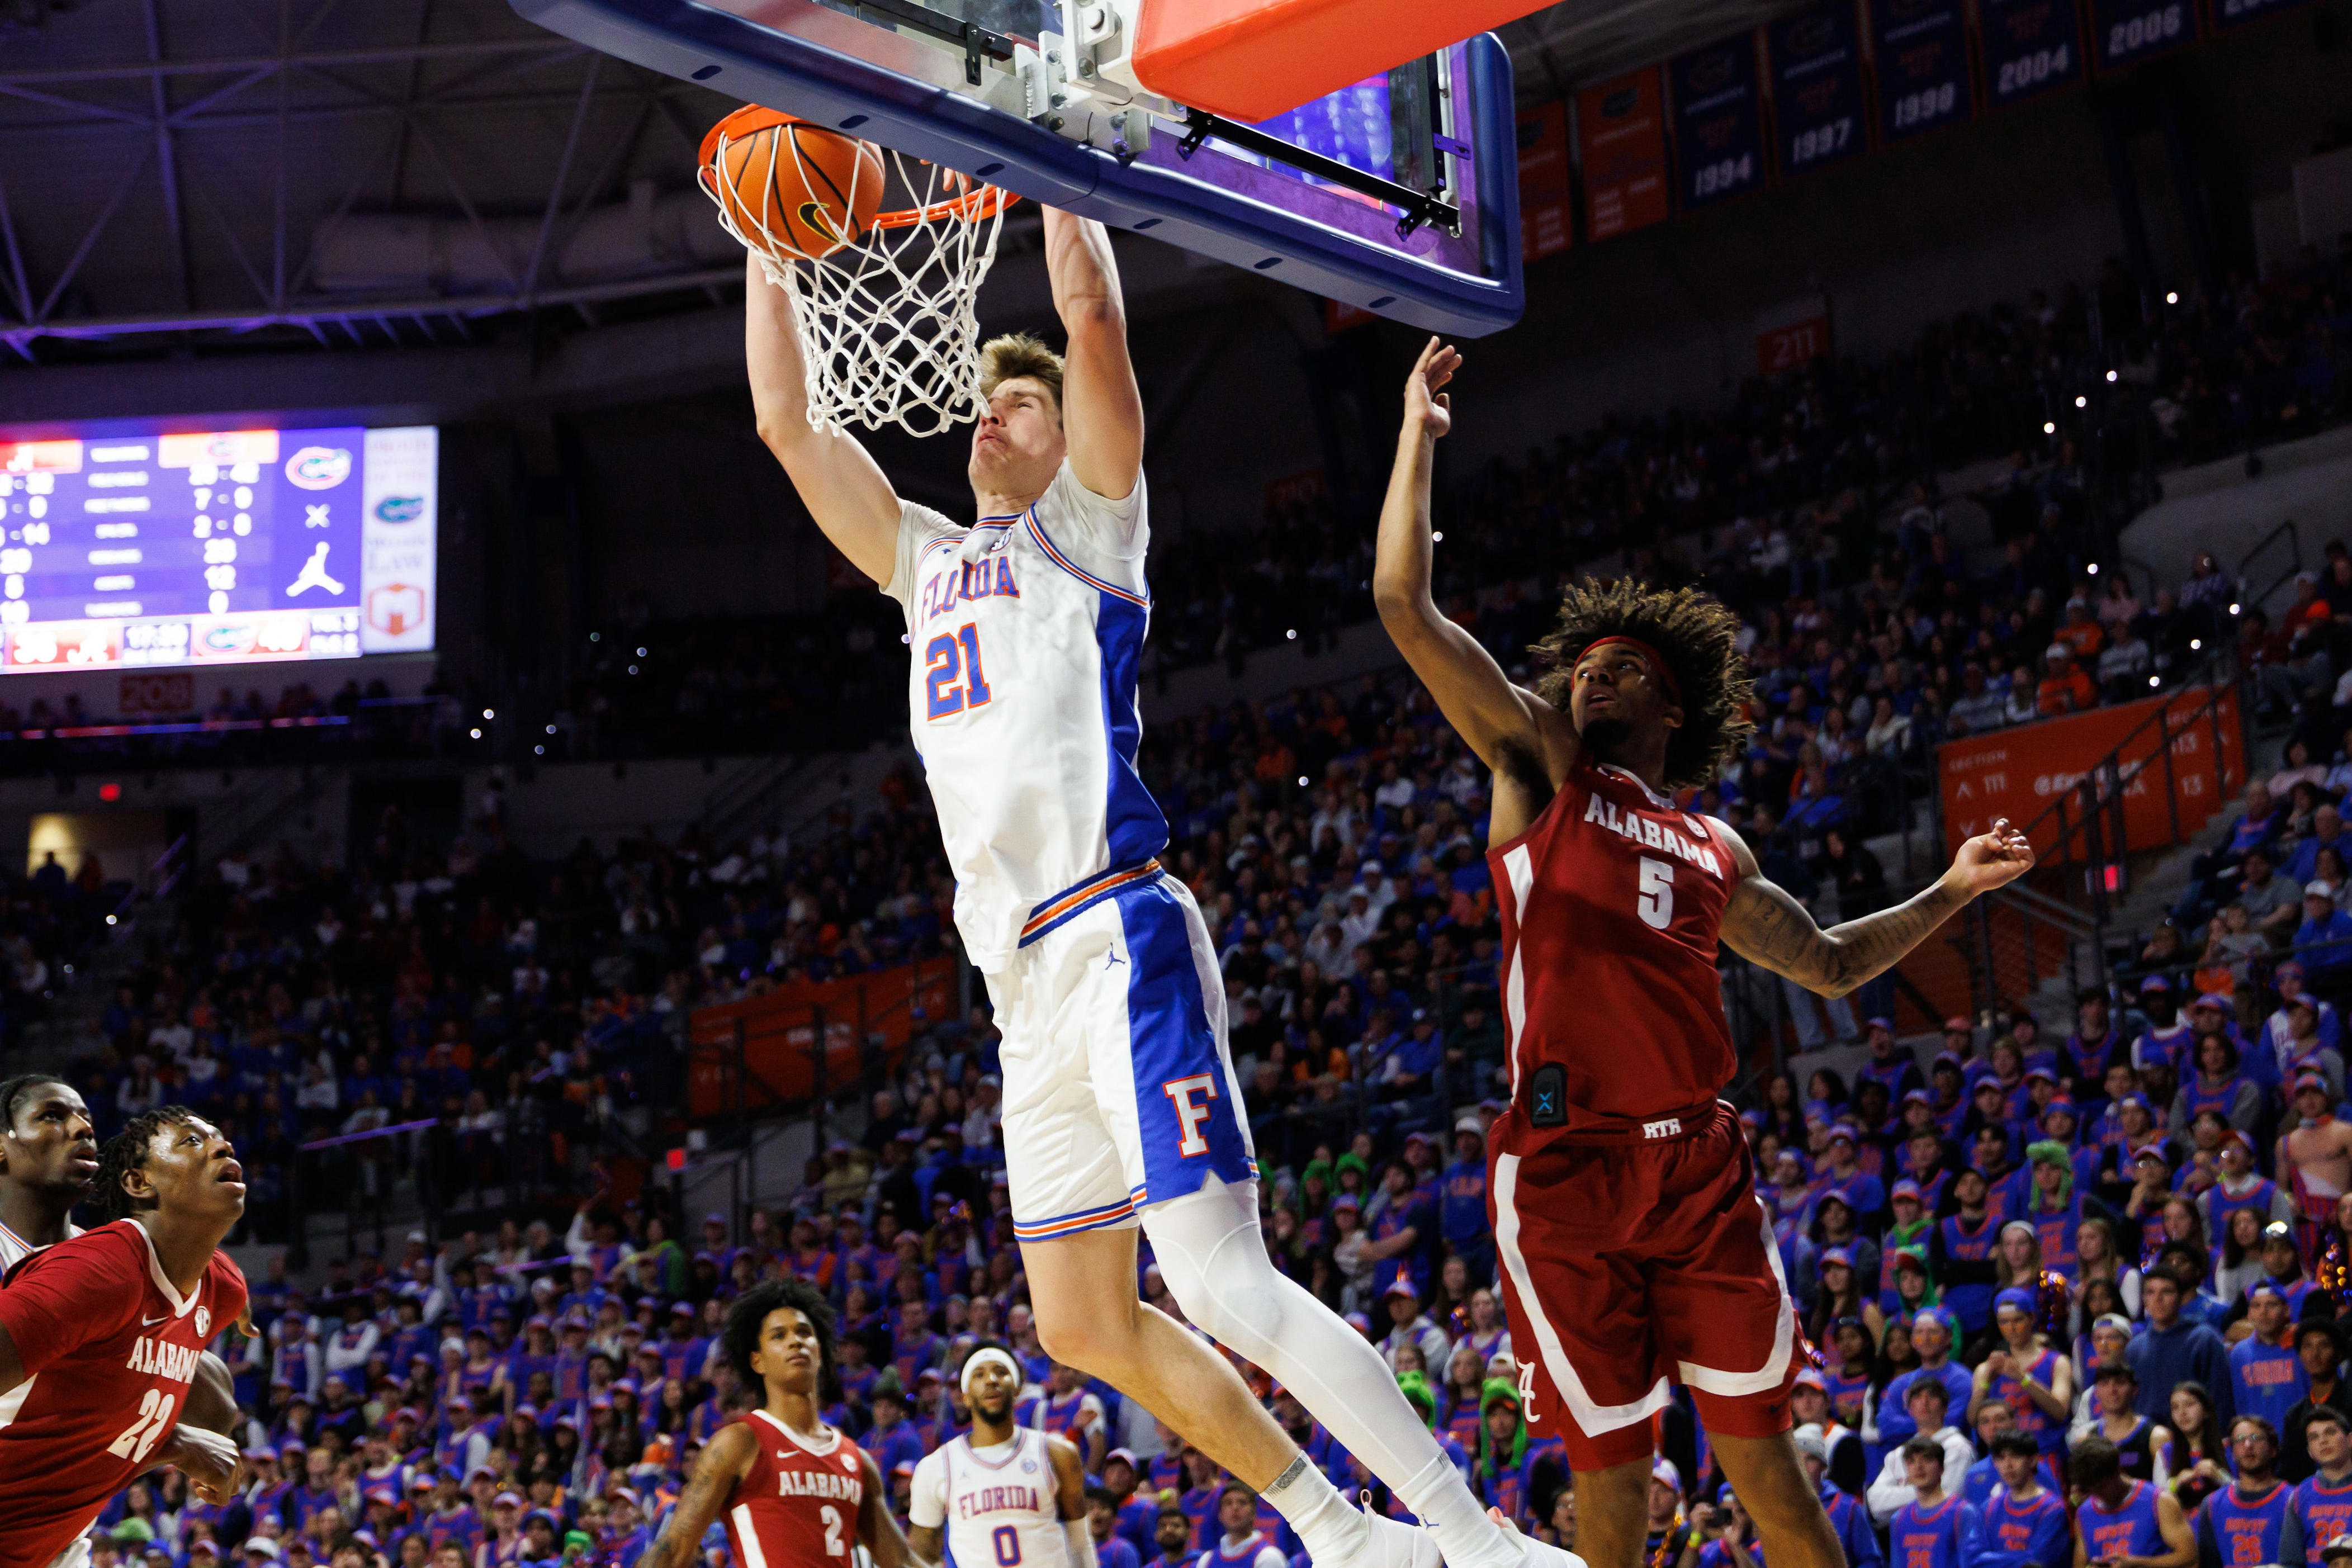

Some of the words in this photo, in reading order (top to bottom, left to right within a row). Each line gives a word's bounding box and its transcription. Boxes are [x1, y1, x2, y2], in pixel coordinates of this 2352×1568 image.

[2108, 3, 2183, 57] 2006
[1998, 41, 2069, 95] 2004
[1792, 116, 1852, 164] 1997
[1695, 151, 1753, 198] 1994
[1772, 326, 1815, 367] 211
[921, 556, 1020, 632] FLOIDA
[925, 622, 991, 722] 21
[1584, 792, 1724, 880] ALABAMA
[1637, 856, 1674, 930] 5
[1162, 1072, 1218, 1159] F
[1643, 1118, 1682, 1139] RTR
[126, 1335, 200, 1385] ALABAM
[106, 1389, 175, 1463] 22
[958, 1486, 1040, 1520] FLORIDA
[820, 1505, 846, 1556] 2
[991, 1524, 1022, 1568] 0
[2232, 1535, 2262, 1564] 26
